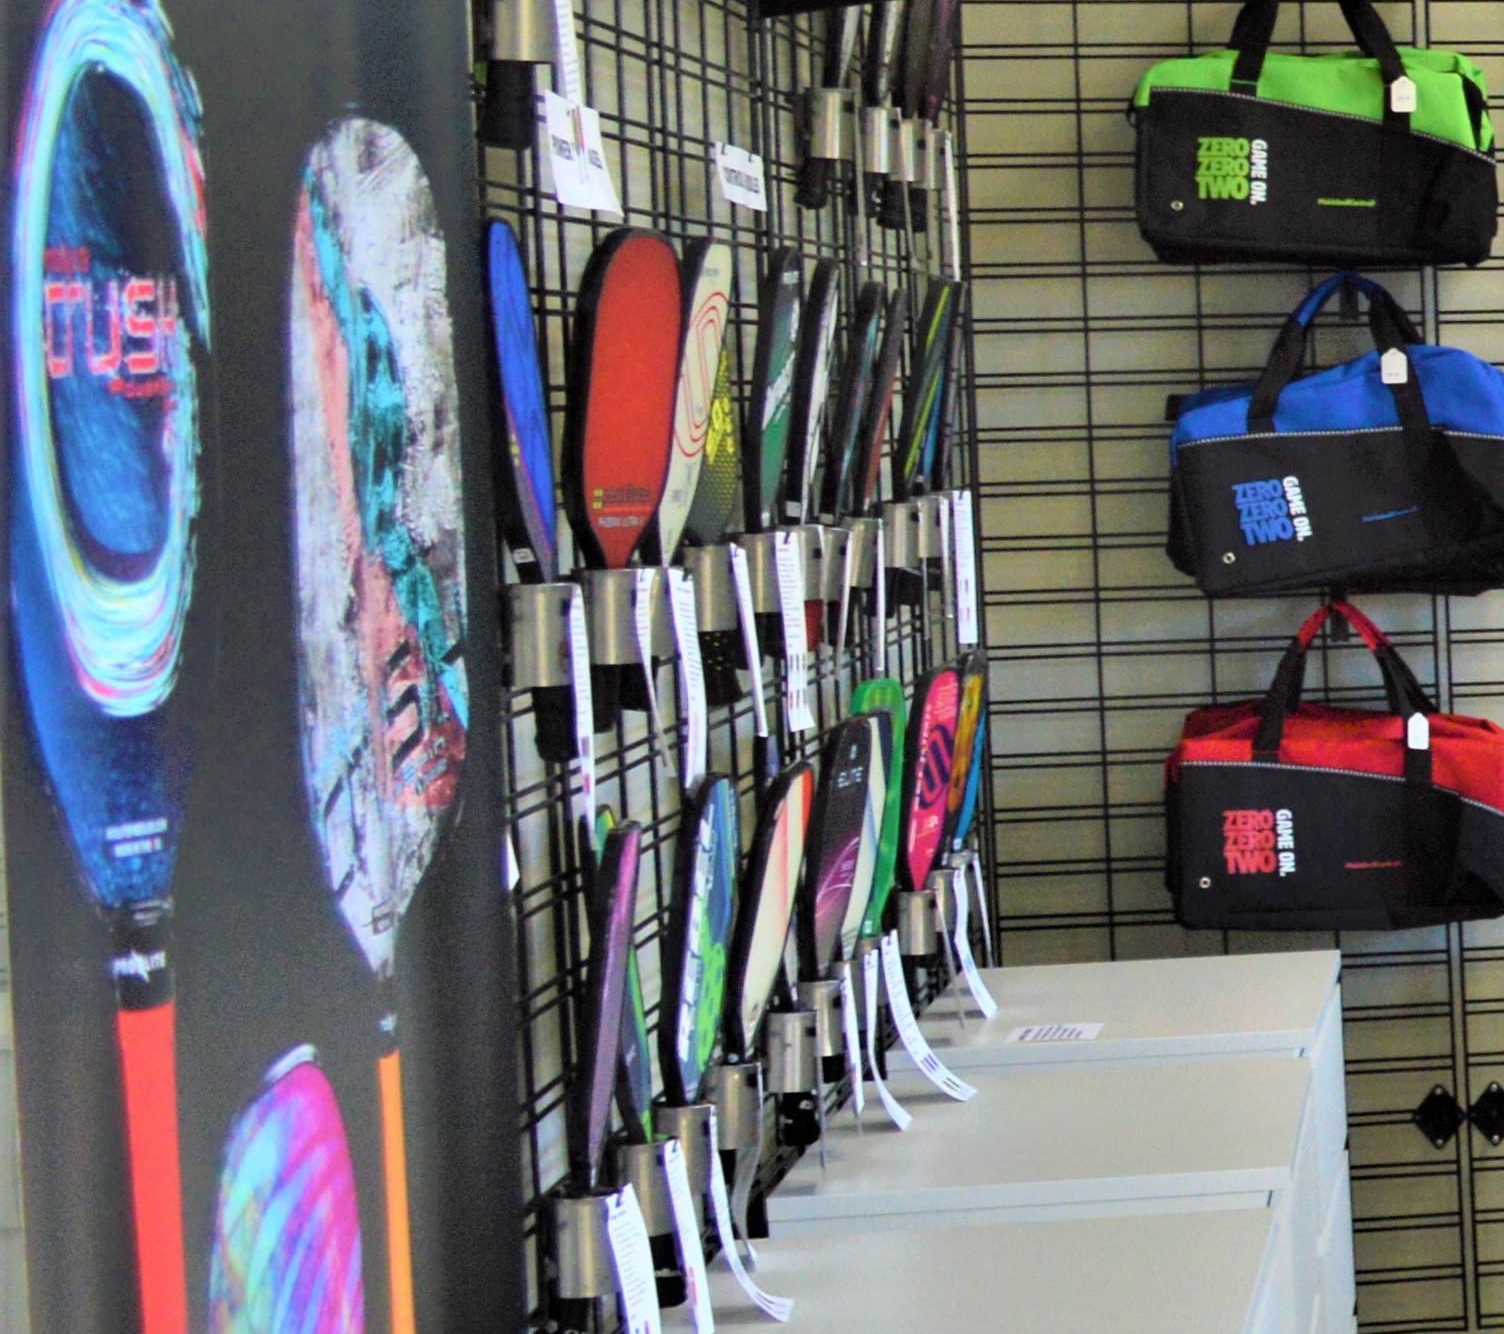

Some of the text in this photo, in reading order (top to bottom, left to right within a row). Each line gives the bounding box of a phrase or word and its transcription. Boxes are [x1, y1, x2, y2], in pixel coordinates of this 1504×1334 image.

[1198, 137, 1250, 157] ZERO
[1251, 138, 1268, 179] GAME
[1197, 157, 1249, 176] ZERO
[1196, 176, 1249, 199] TWO
[1232, 479, 1283, 502] ZERO
[1282, 476, 1306, 516] GAME
[1236, 499, 1288, 523] ZERO
[1240, 518, 1295, 546] TWO
[1223, 810, 1274, 830] ZERO
[1276, 809, 1294, 849] GAME
[1223, 830, 1276, 850] ZERO
[1224, 850, 1276, 874] TWO
